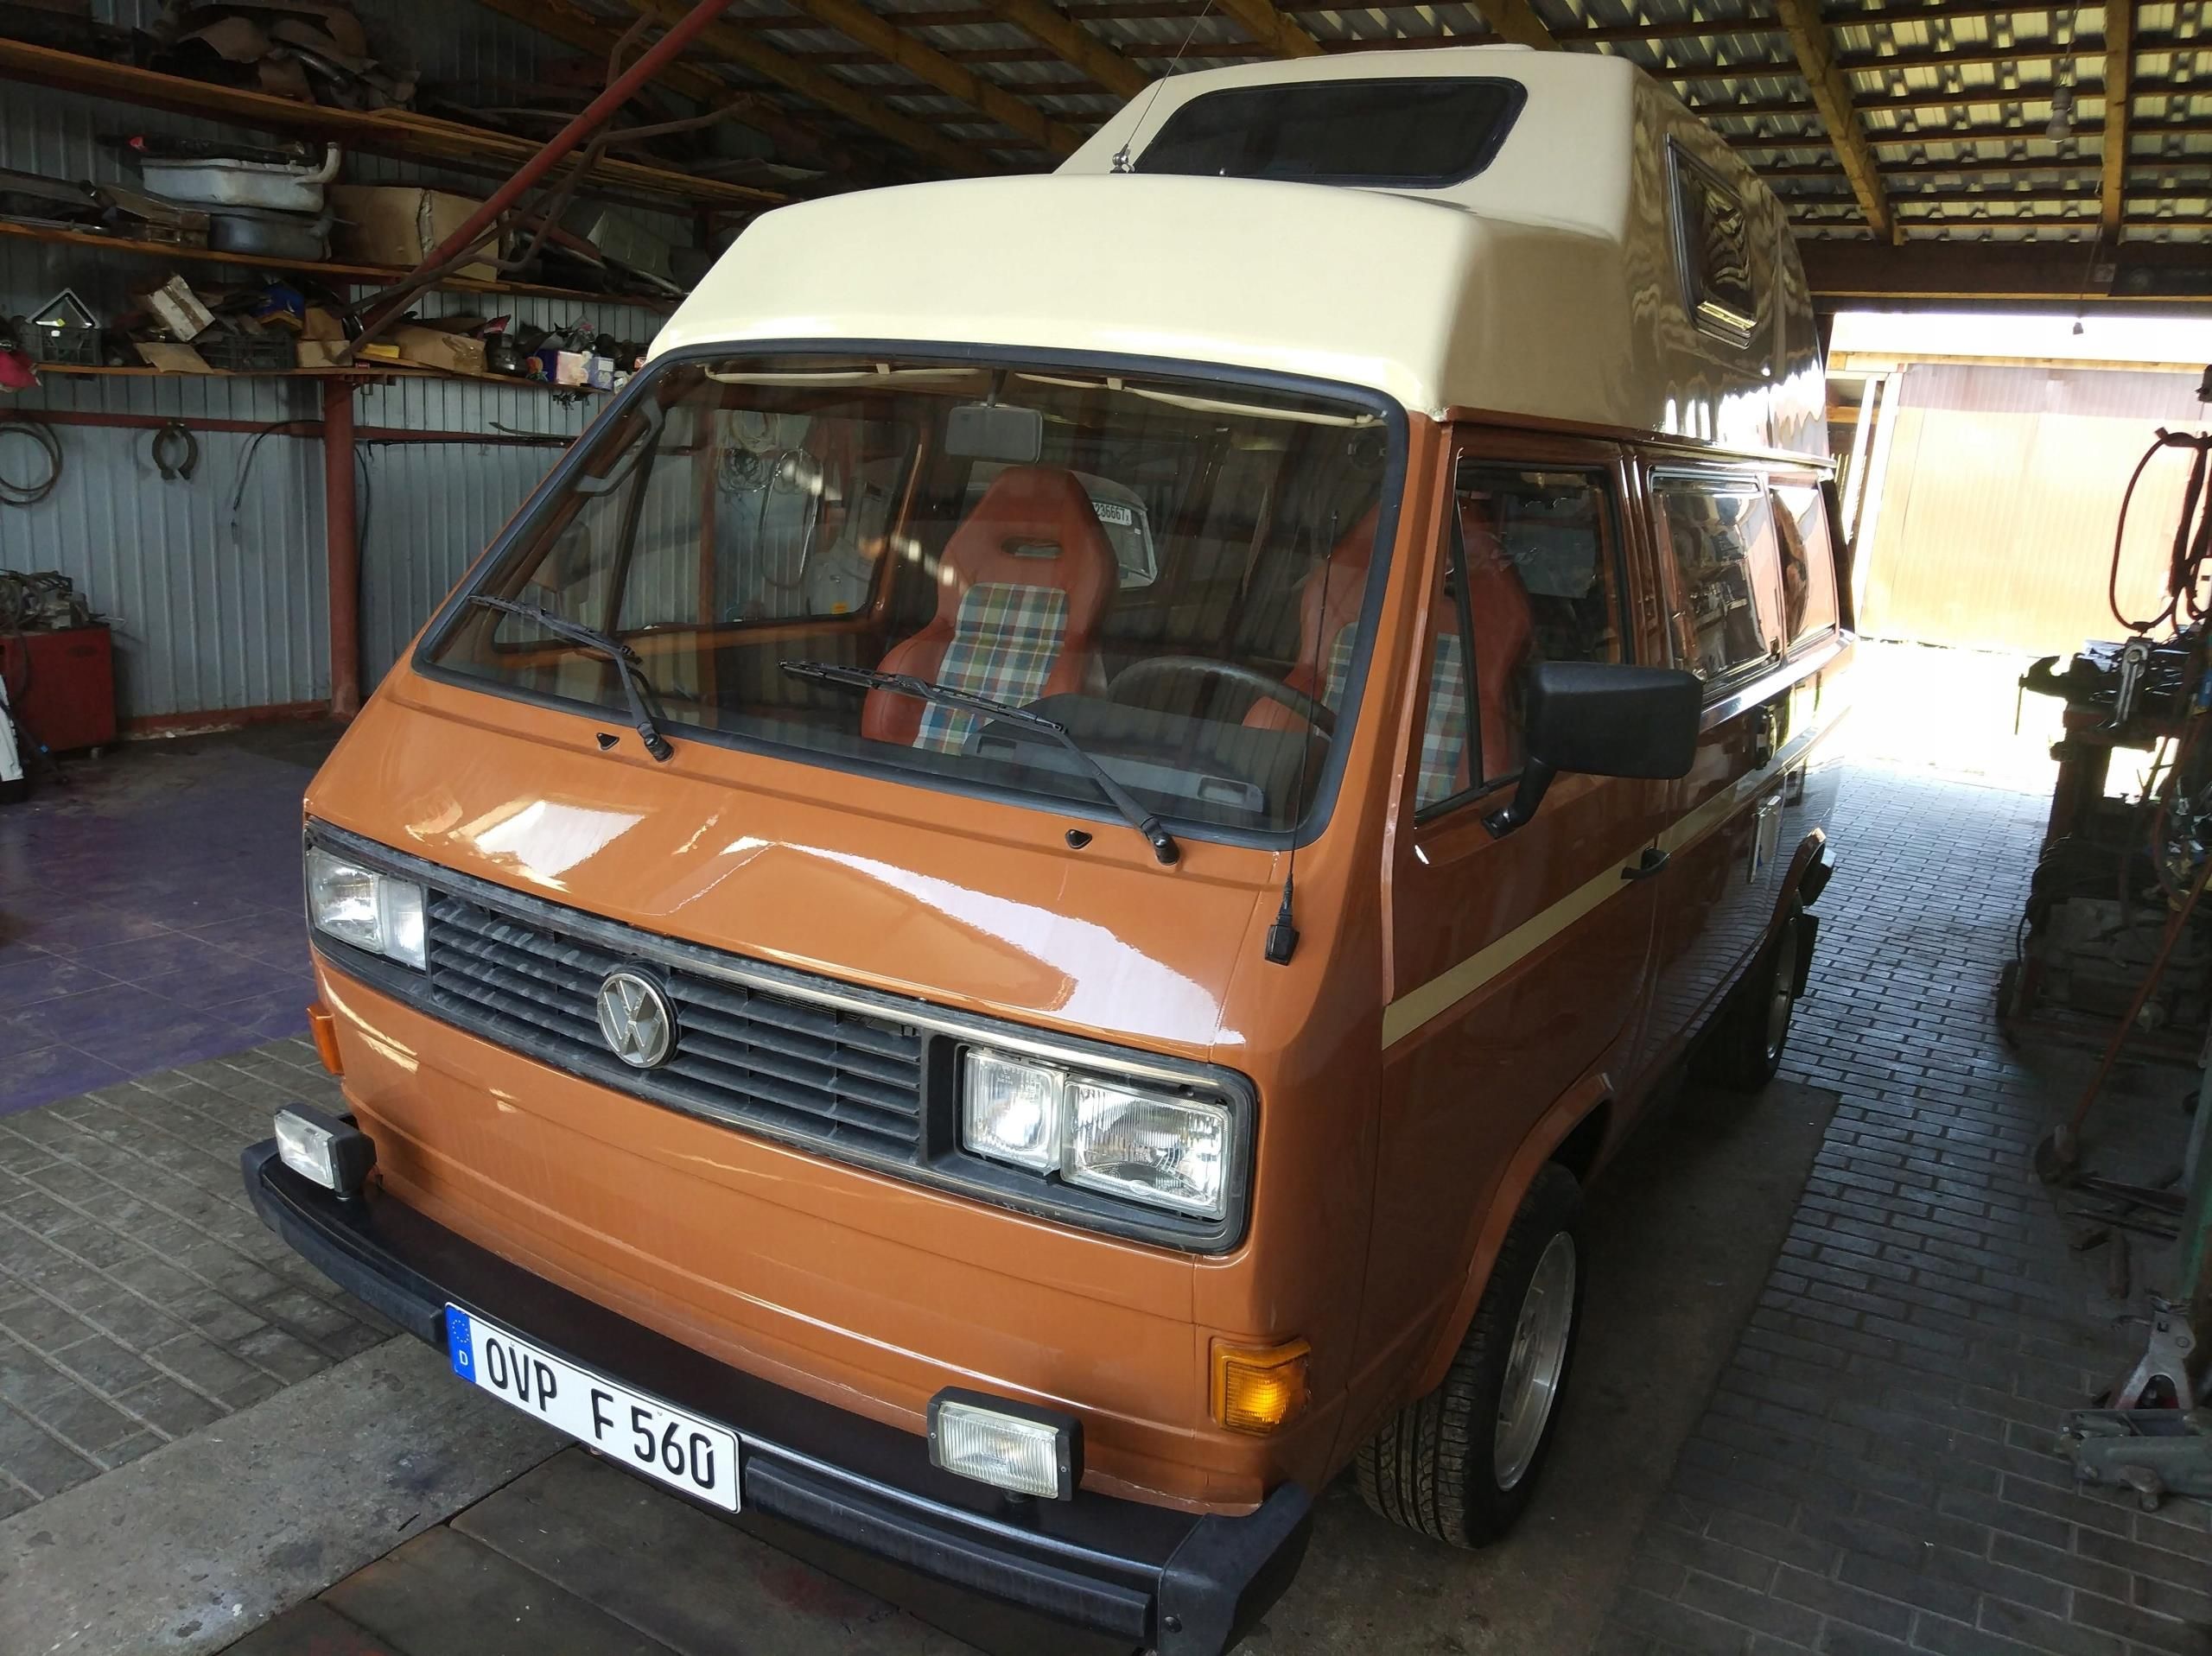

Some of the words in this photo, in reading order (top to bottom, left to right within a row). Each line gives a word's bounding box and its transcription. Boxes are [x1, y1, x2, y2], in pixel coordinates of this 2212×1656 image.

[459, 1348, 469, 1366] D
[486, 1337, 557, 1412] OVP
[591, 1388, 614, 1440] F
[631, 1405, 715, 1490] 560
